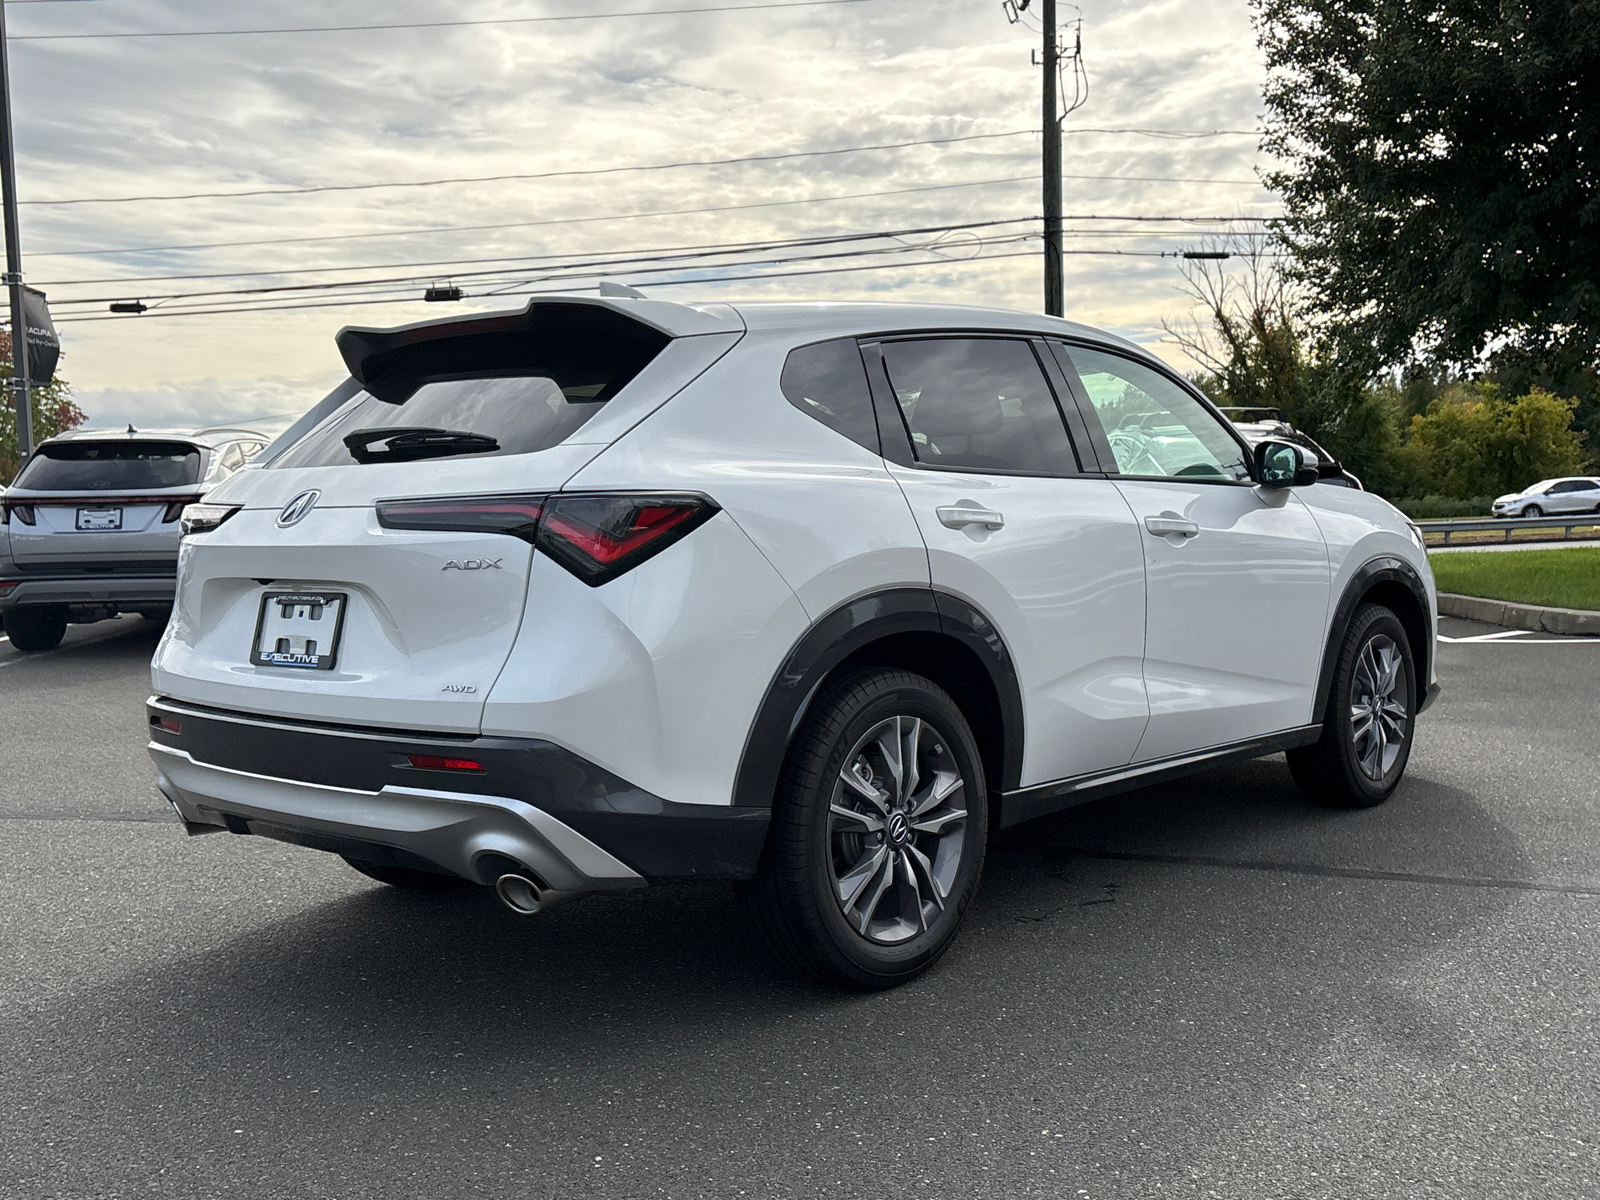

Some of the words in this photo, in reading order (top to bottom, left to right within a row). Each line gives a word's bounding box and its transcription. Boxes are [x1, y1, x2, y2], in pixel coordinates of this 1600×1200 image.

[28, 326, 52, 338] ACURA
[441, 557, 503, 571] ADX
[260, 652, 319, 664] EXECUTIVE
[441, 684, 477, 694] AWD
